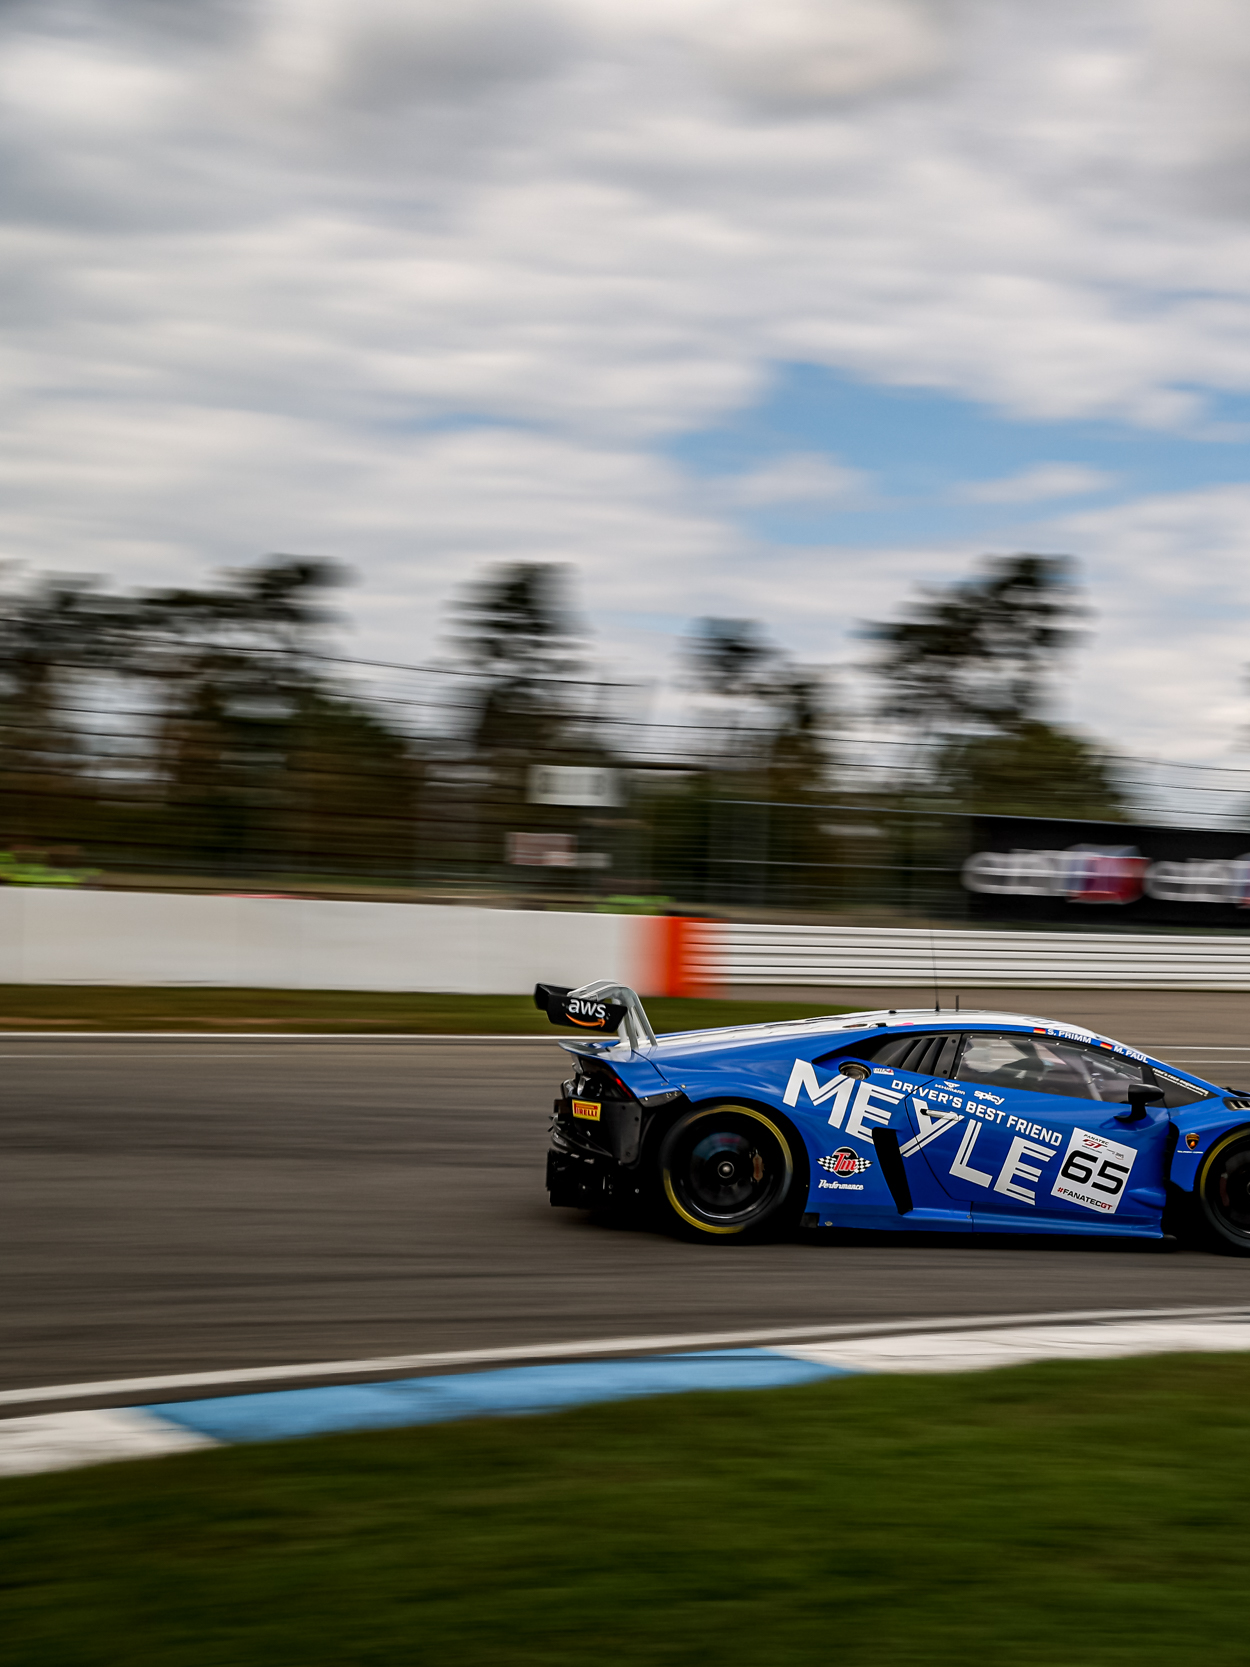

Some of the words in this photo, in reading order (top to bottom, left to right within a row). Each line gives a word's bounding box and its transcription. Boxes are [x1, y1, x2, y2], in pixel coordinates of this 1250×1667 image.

[568, 999, 607, 1018] aws
[1058, 1030, 1092, 1044] PRIMM
[1113, 1045, 1125, 1055] M.
[1125, 1050, 1149, 1064] PAUL
[973, 1090, 1005, 1106] spicy
[891, 1079, 963, 1108] DRIVER'S
[965, 1101, 1006, 1124] BEST
[1006, 1115, 1063, 1146] FRIEND
[782, 1058, 1057, 1206] MEYLE
[1060, 1149, 1130, 1195] 65
[1057, 1187, 1113, 1211] #FANATECGT
